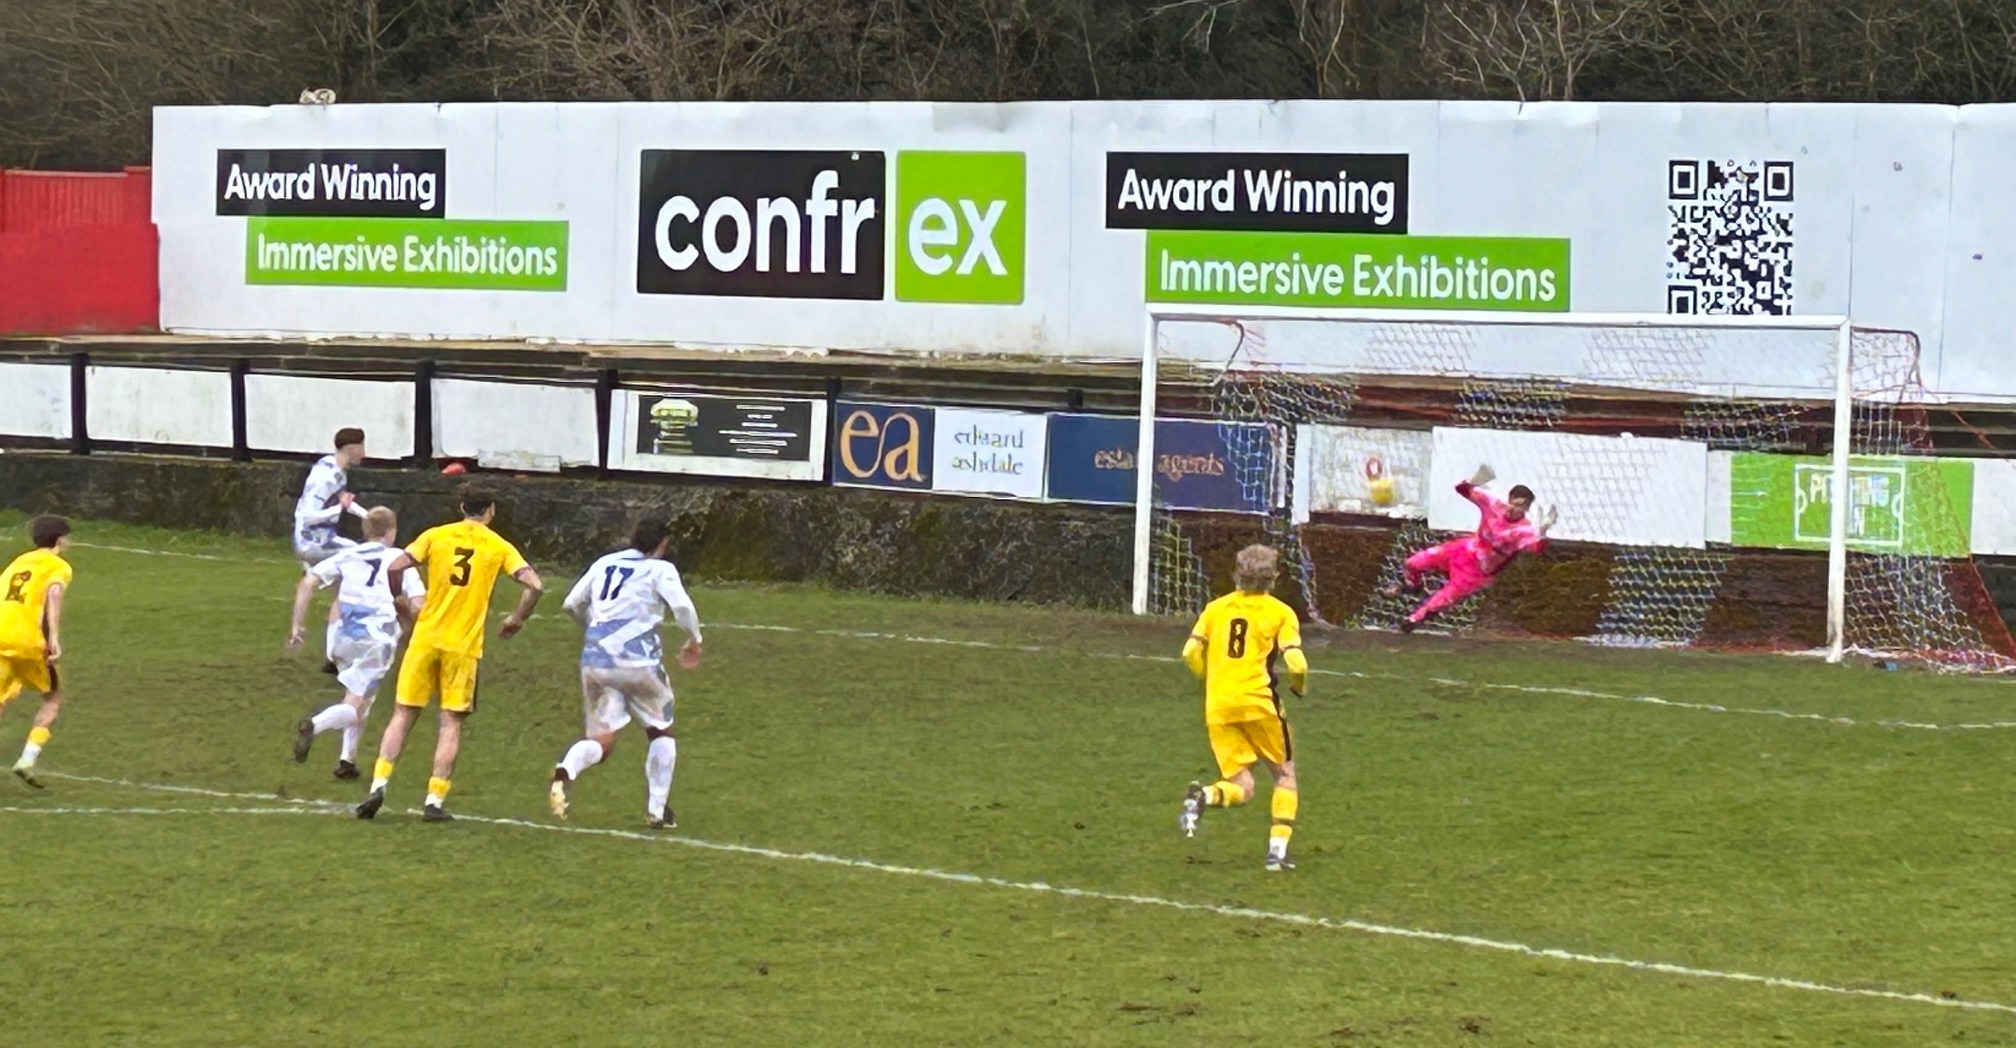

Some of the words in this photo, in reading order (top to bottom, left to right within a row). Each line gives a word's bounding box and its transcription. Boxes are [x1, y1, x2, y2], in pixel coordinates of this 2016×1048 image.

[224, 163, 315, 200] Award
[320, 163, 437, 211] Winning
[1118, 168, 1235, 212] Award
[1243, 169, 1395, 226] Winning
[257, 233, 398, 273] Immersive
[403, 234, 558, 276] Exhibitions
[1160, 248, 1345, 296] Immersive
[1353, 253, 1556, 302] Exhibitions
[840, 410, 923, 482] ea
[363, 558, 382, 587] 7
[449, 546, 475, 587] 3
[599, 564, 635, 601] 17
[1227, 617, 1249, 659] 8
